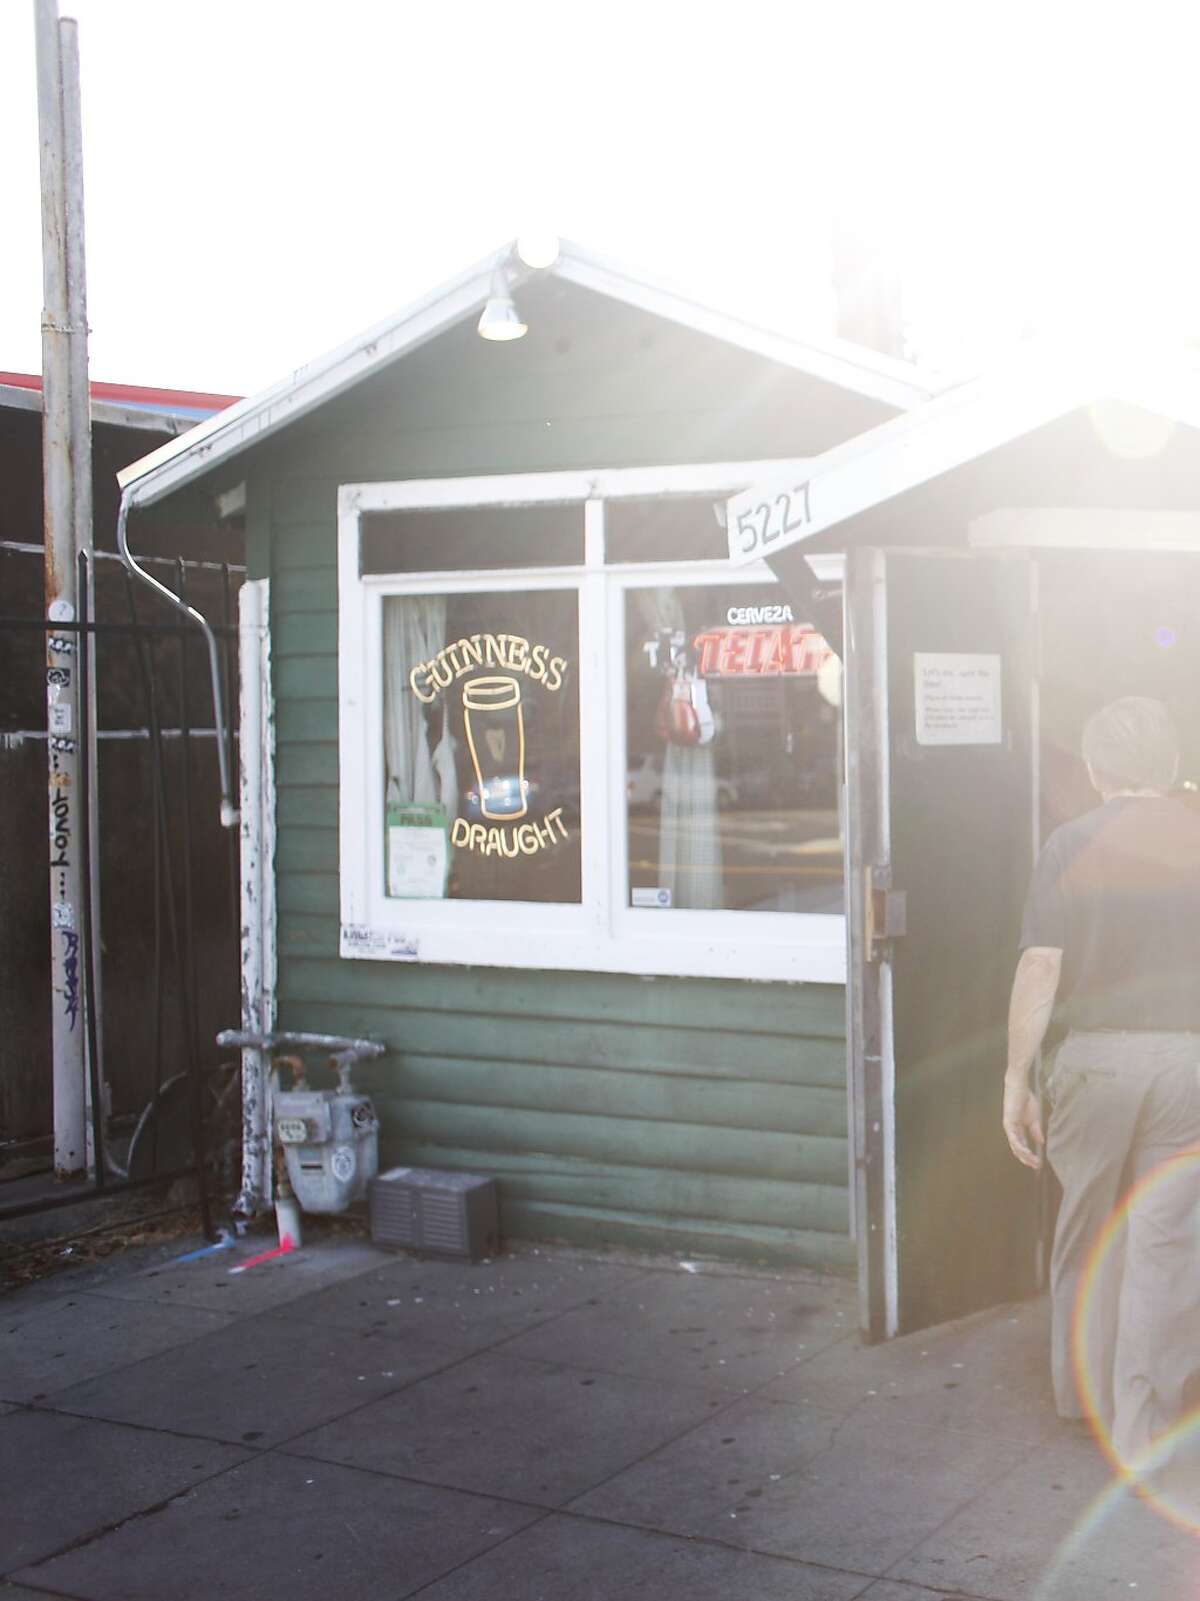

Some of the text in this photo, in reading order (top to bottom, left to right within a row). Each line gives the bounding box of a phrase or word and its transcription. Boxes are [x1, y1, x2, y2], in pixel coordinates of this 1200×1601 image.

[737, 480, 810, 553] 5227
[726, 604, 794, 625] CERVEZA
[410, 634, 567, 702] GUINNESS
[452, 808, 568, 857] DRAUGHT
